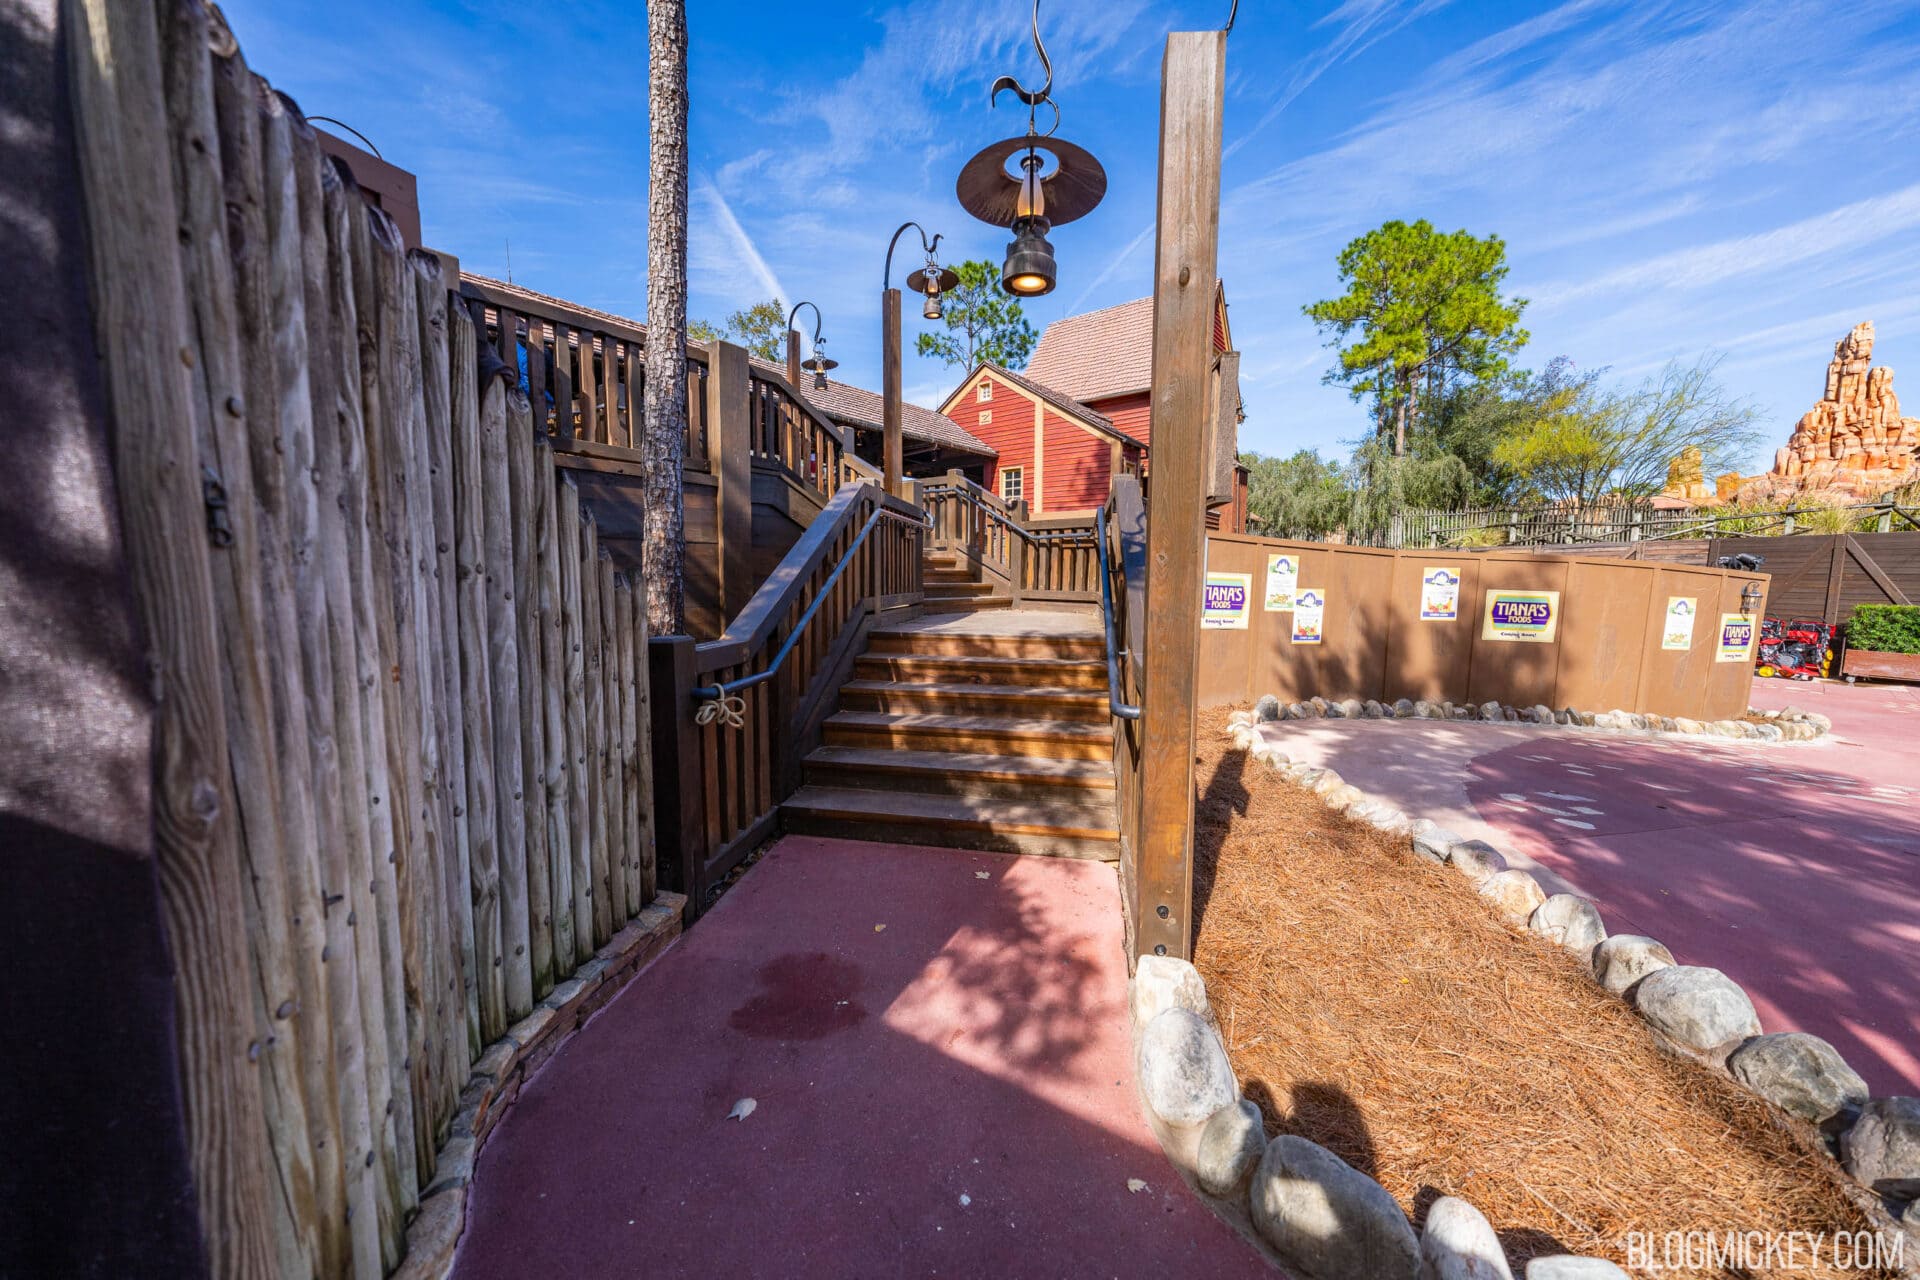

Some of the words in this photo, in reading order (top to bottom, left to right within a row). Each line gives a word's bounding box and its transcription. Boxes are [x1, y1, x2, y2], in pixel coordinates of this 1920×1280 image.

[1496, 603, 1547, 617] TIANA'S
[1508, 615, 1532, 624] FOODS
[1726, 626, 1750, 638] TIANA'S
